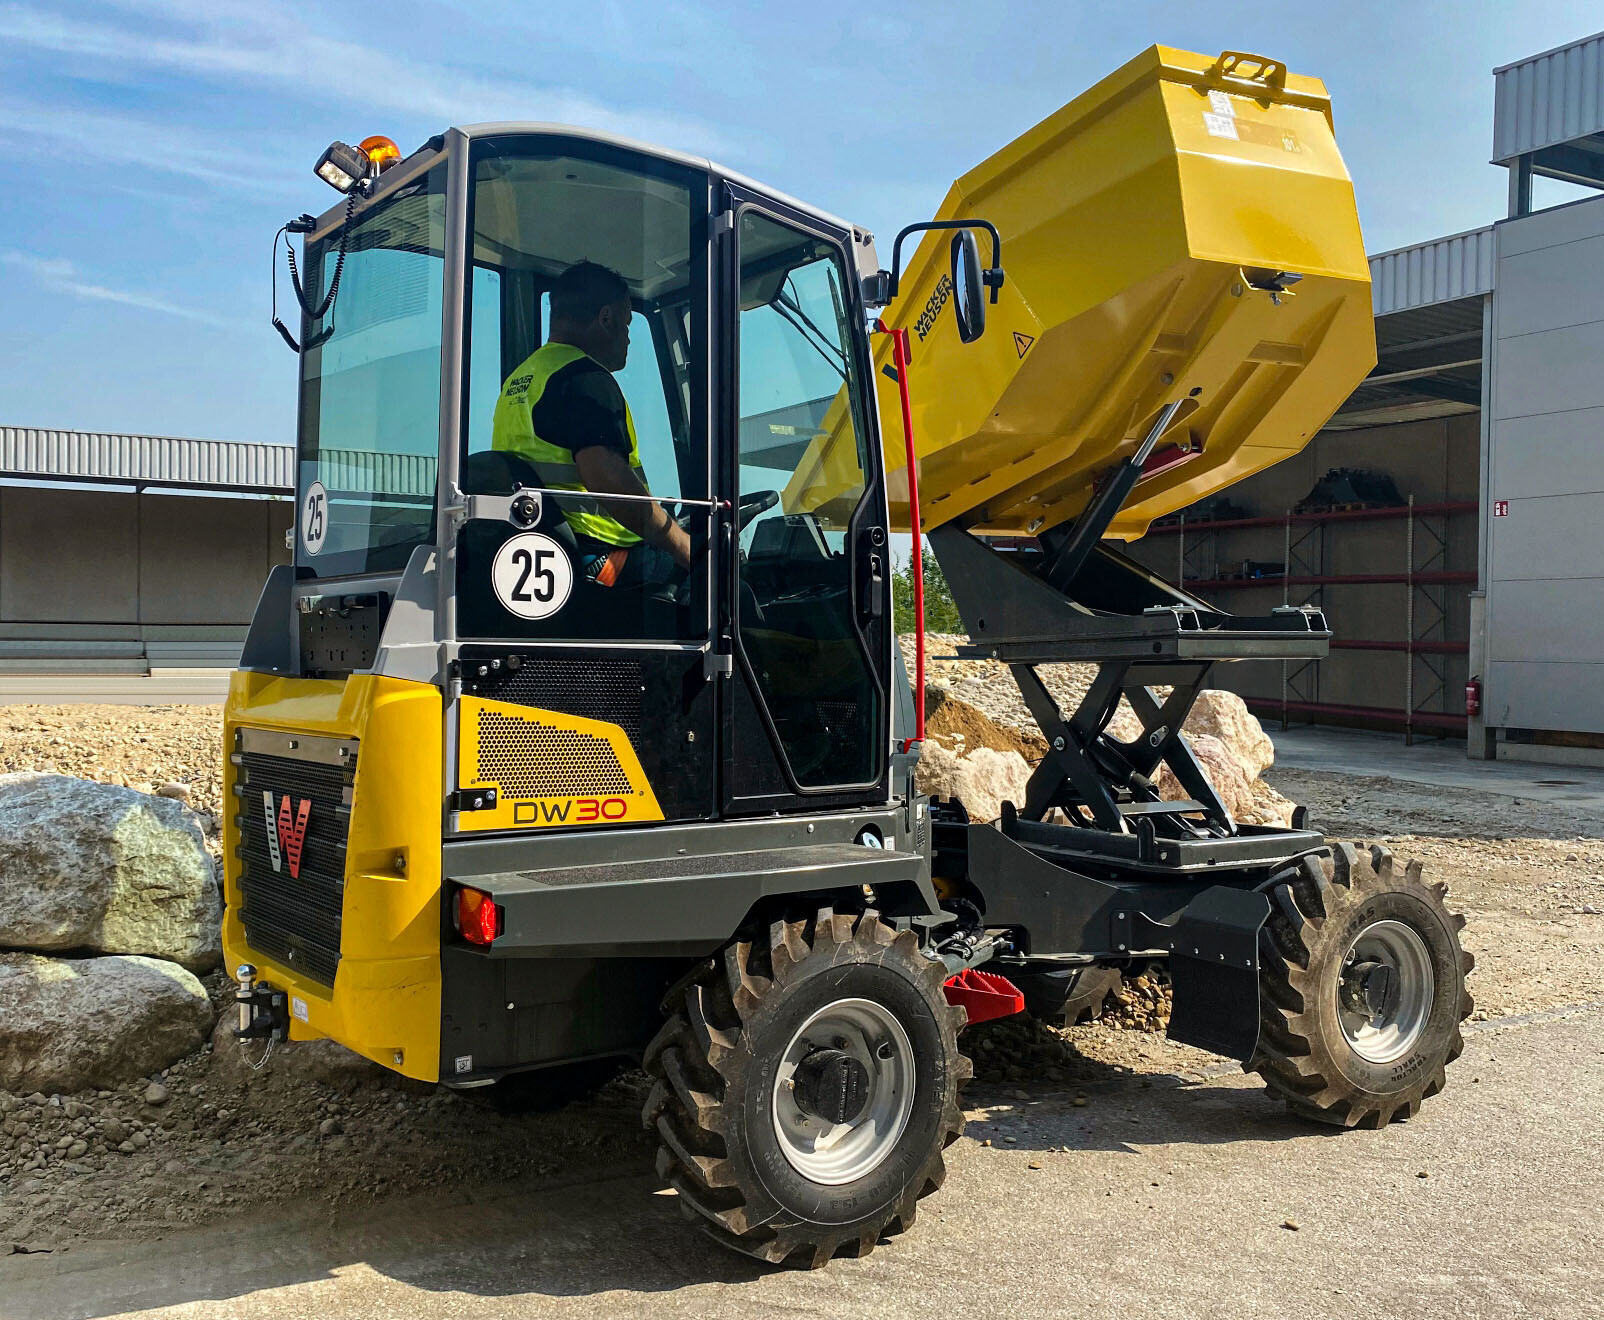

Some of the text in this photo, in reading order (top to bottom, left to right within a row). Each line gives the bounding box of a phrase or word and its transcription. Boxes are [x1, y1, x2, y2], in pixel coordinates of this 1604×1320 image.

[913, 274, 950, 331] WACKER
[918, 281, 953, 342] NEUSON
[307, 493, 324, 542] 25
[511, 549, 555, 602] 25
[514, 798, 628, 825] DW30
